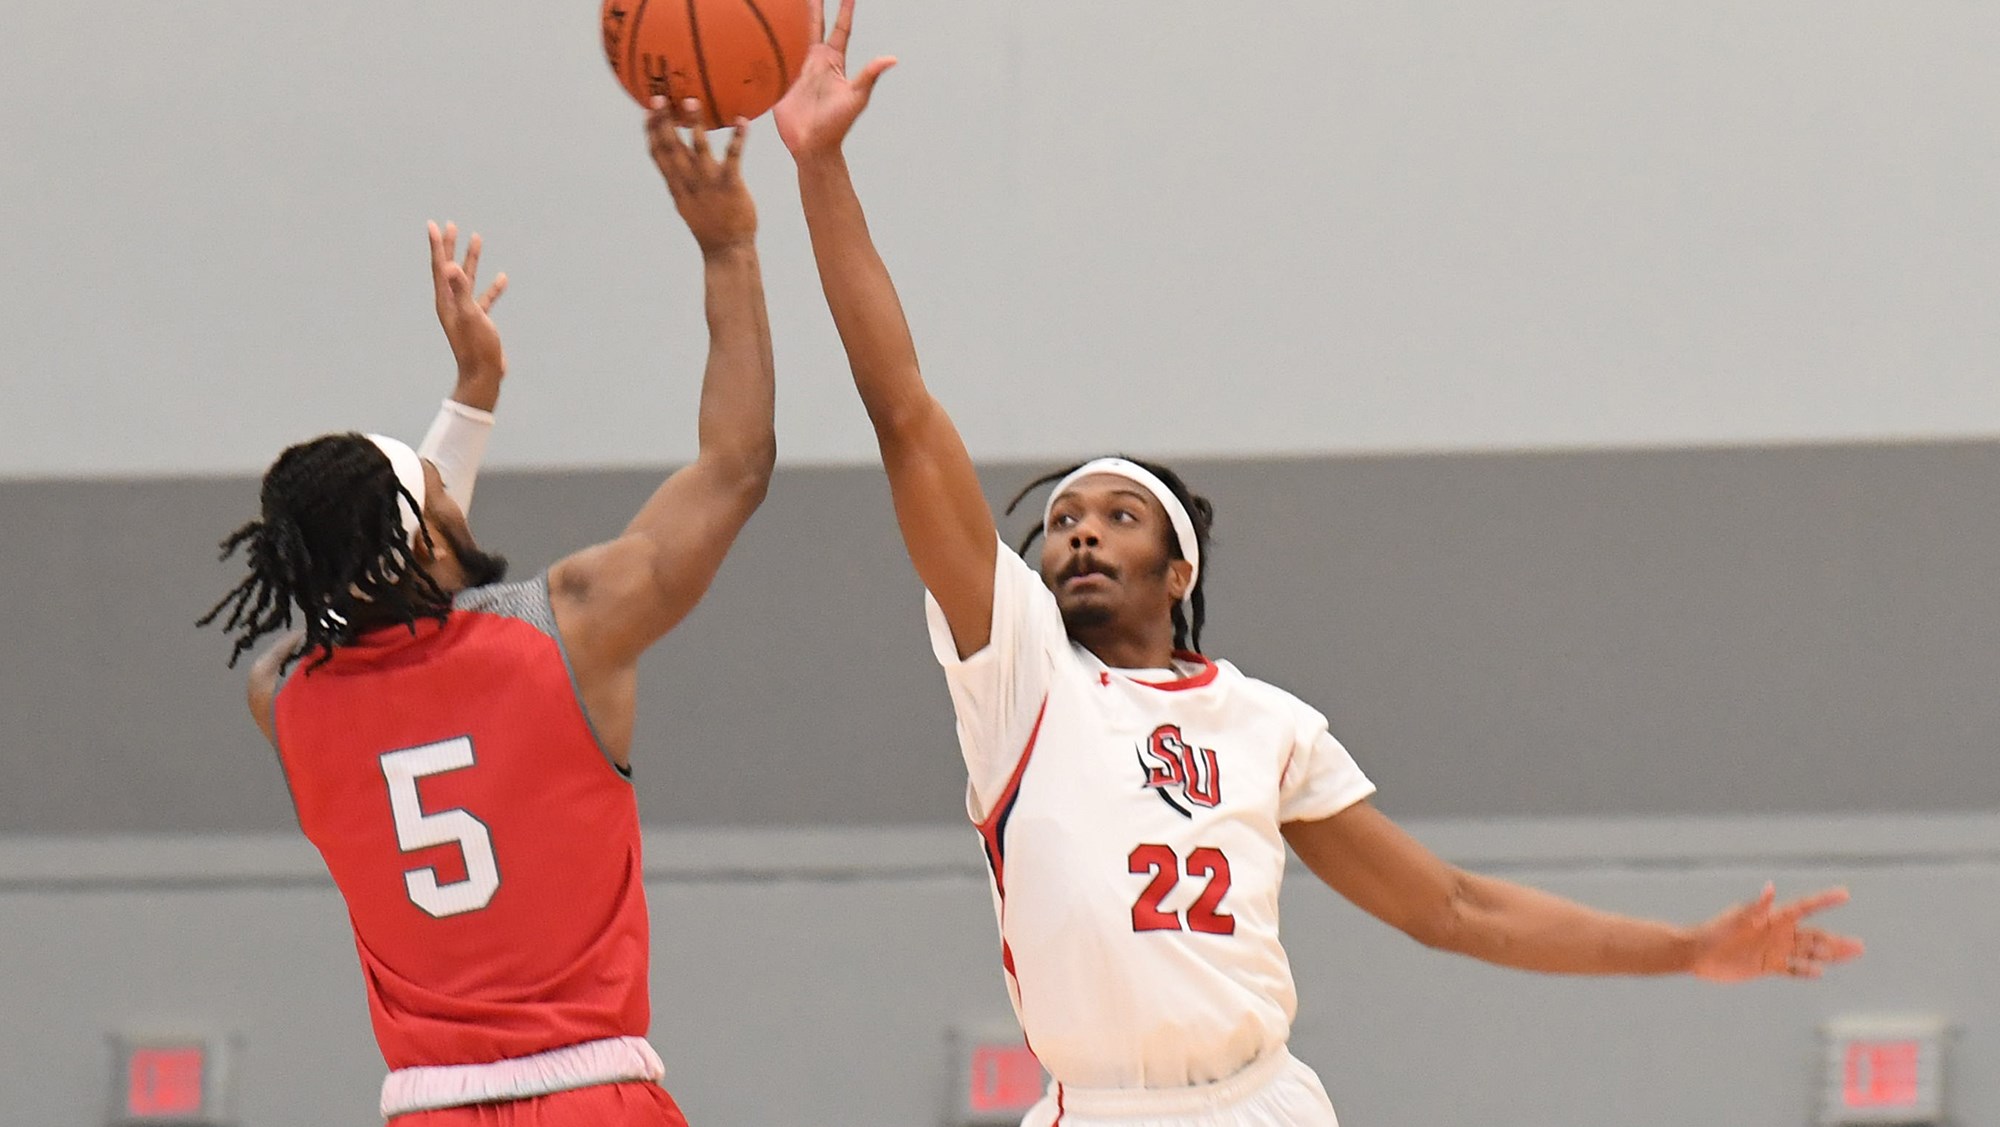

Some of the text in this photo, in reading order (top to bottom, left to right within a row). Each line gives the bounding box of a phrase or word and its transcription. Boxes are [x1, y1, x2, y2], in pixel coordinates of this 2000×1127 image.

[1142, 723, 1222, 808] SU
[379, 734, 502, 919] 5
[1128, 843, 1236, 936] 22
